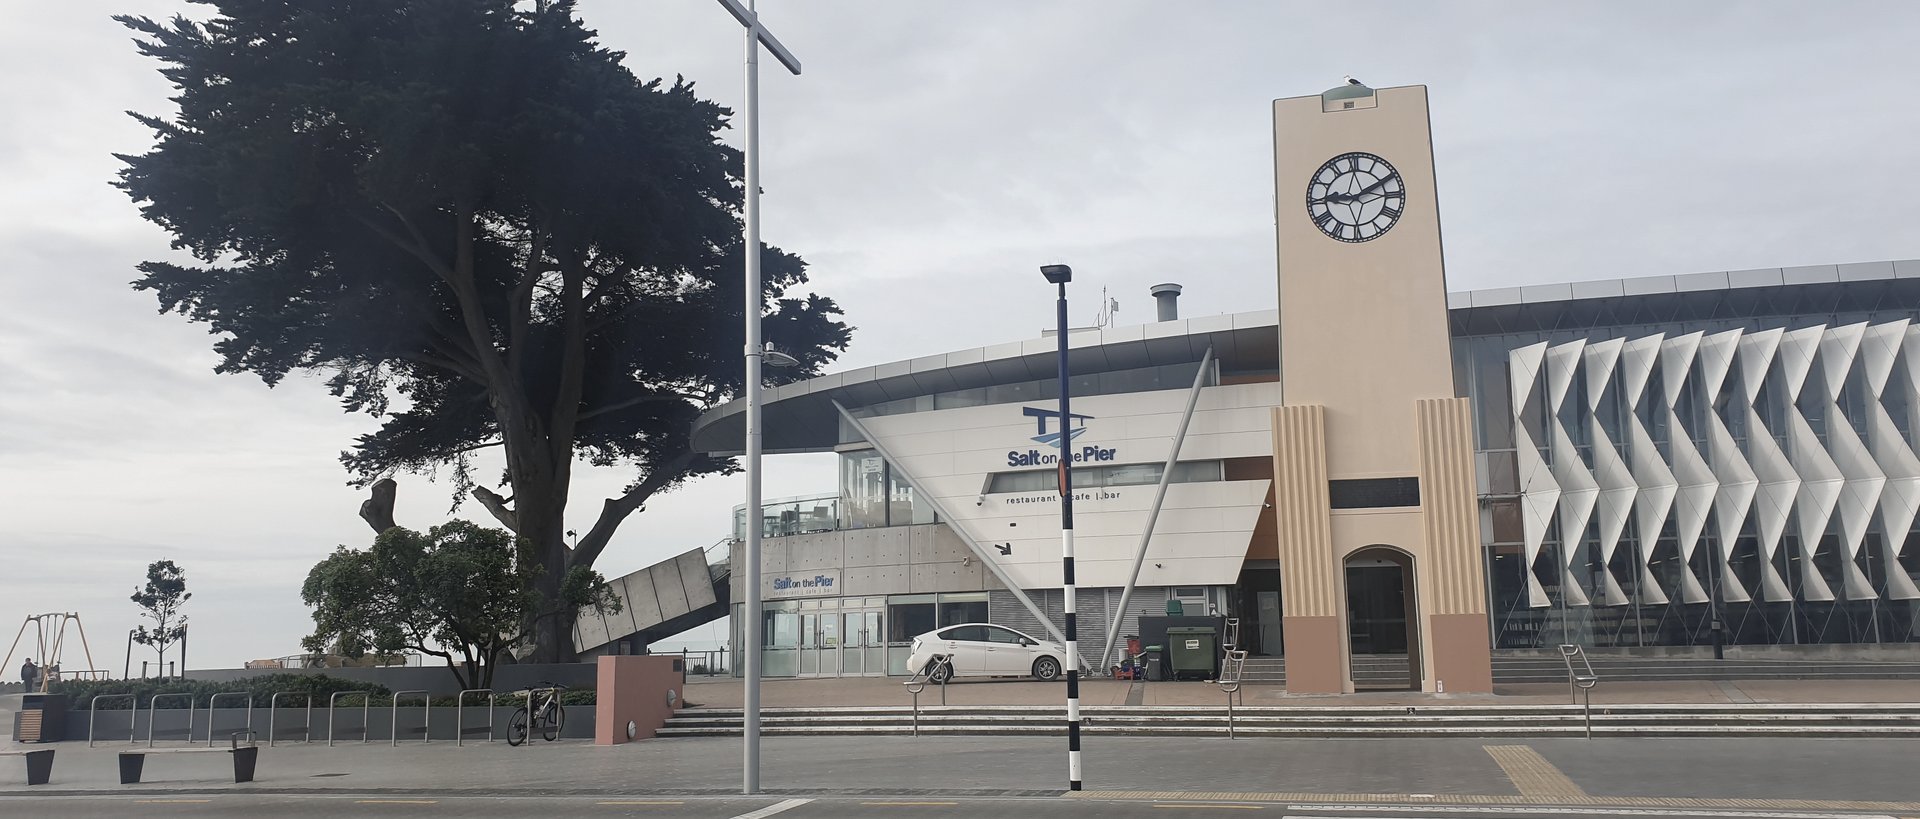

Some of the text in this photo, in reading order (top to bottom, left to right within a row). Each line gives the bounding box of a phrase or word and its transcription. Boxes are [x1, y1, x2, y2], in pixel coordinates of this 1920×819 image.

[1007, 449, 1041, 467] Salt
[1041, 454, 1057, 464] on
[1082, 445, 1116, 462] Pier
[1006, 495, 1056, 504] restaurant
[773, 575, 834, 590] Salt on the Pier
